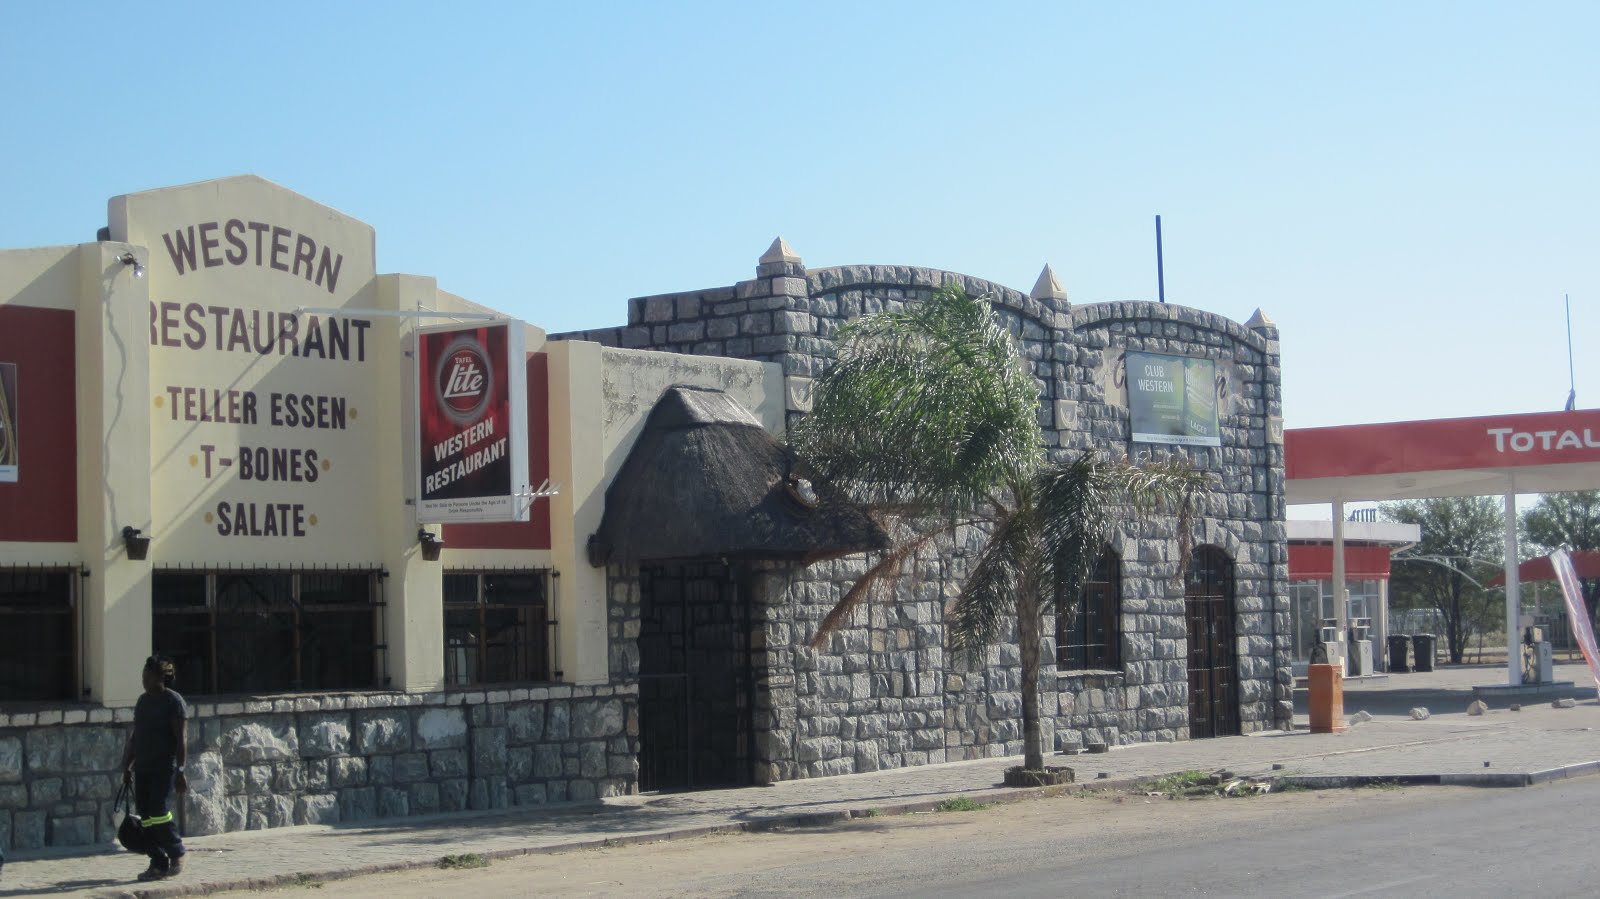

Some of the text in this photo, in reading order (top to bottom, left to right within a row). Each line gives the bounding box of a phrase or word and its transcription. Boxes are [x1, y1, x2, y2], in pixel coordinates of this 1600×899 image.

[162, 219, 343, 294] WESTERN
[1138, 379, 1174, 393] WESTERN
[1144, 365, 1165, 377] CLUB
[166, 386, 346, 430] TELLER ESSEN
[434, 417, 494, 462] WESTERN
[1487, 427, 1600, 453] TOTAL
[239, 447, 318, 483] BONES
[426, 437, 507, 494] RESTAURANT
[217, 501, 306, 537] SALATE
